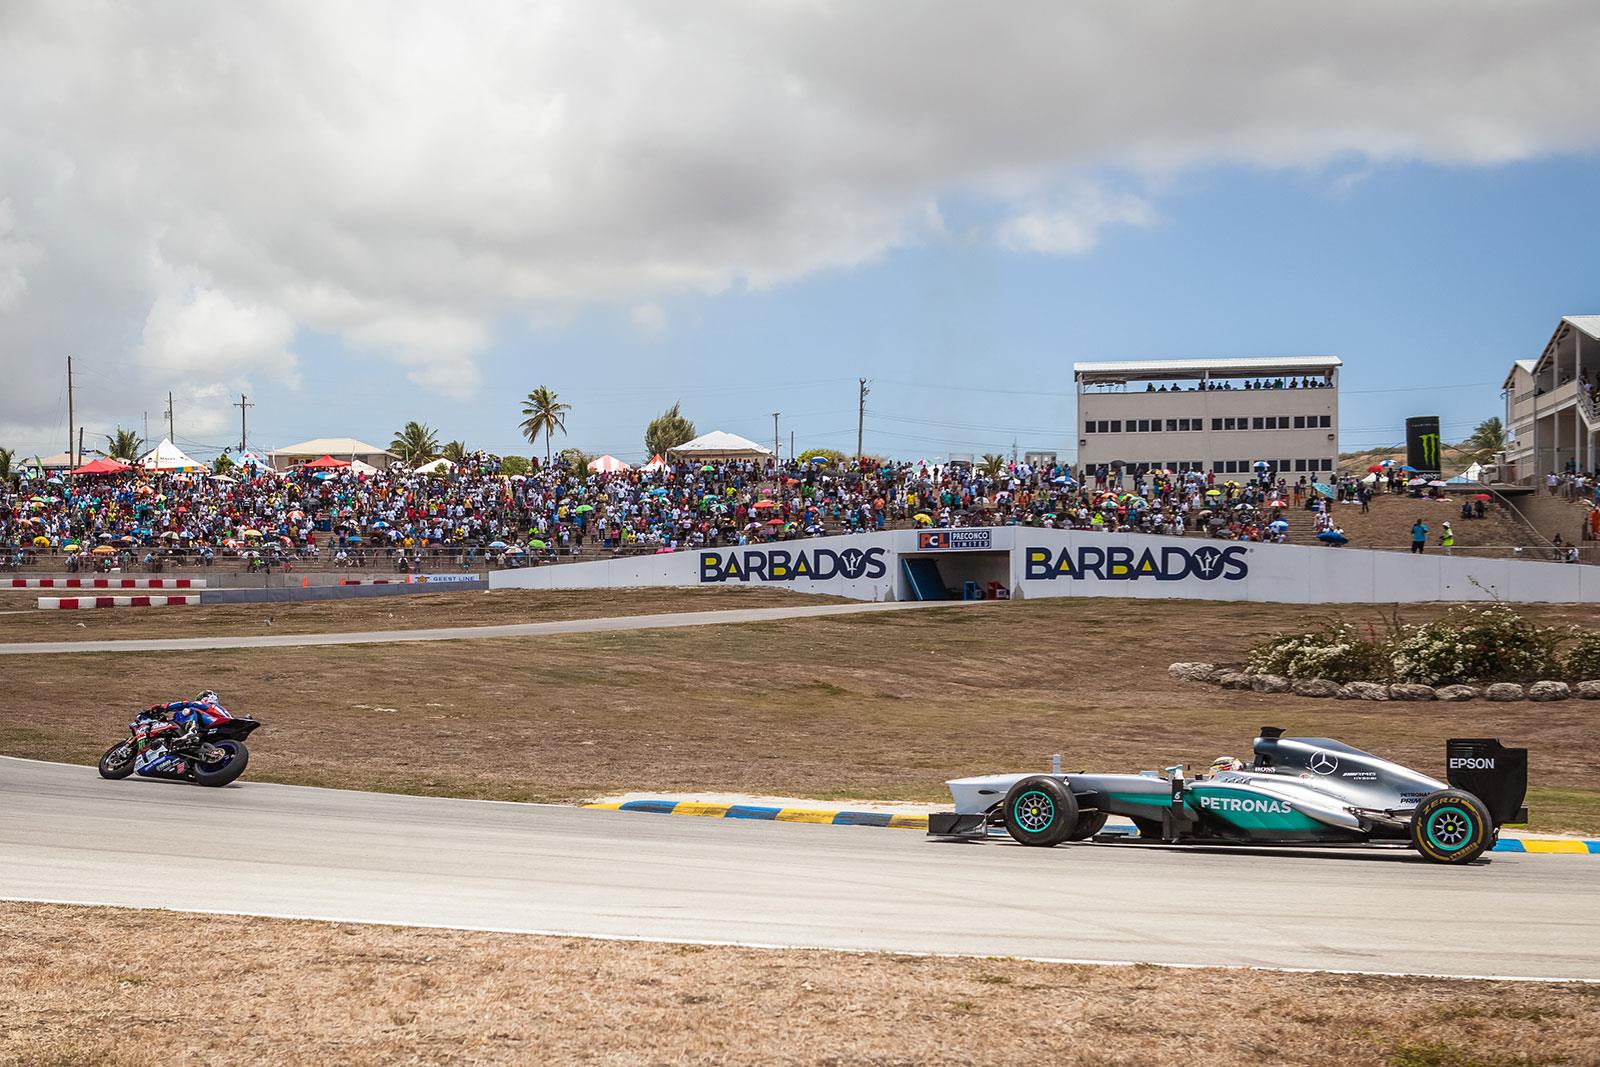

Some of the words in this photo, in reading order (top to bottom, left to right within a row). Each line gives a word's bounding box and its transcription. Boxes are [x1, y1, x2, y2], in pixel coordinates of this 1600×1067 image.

[920, 532, 950, 548] PCL
[700, 547, 887, 582] BARBADOS
[1025, 546, 1248, 580] BARBADOS
[1450, 757, 1495, 770] EPSON
[1174, 791, 1182, 800] 6
[1200, 796, 1292, 814] PETRONAS
